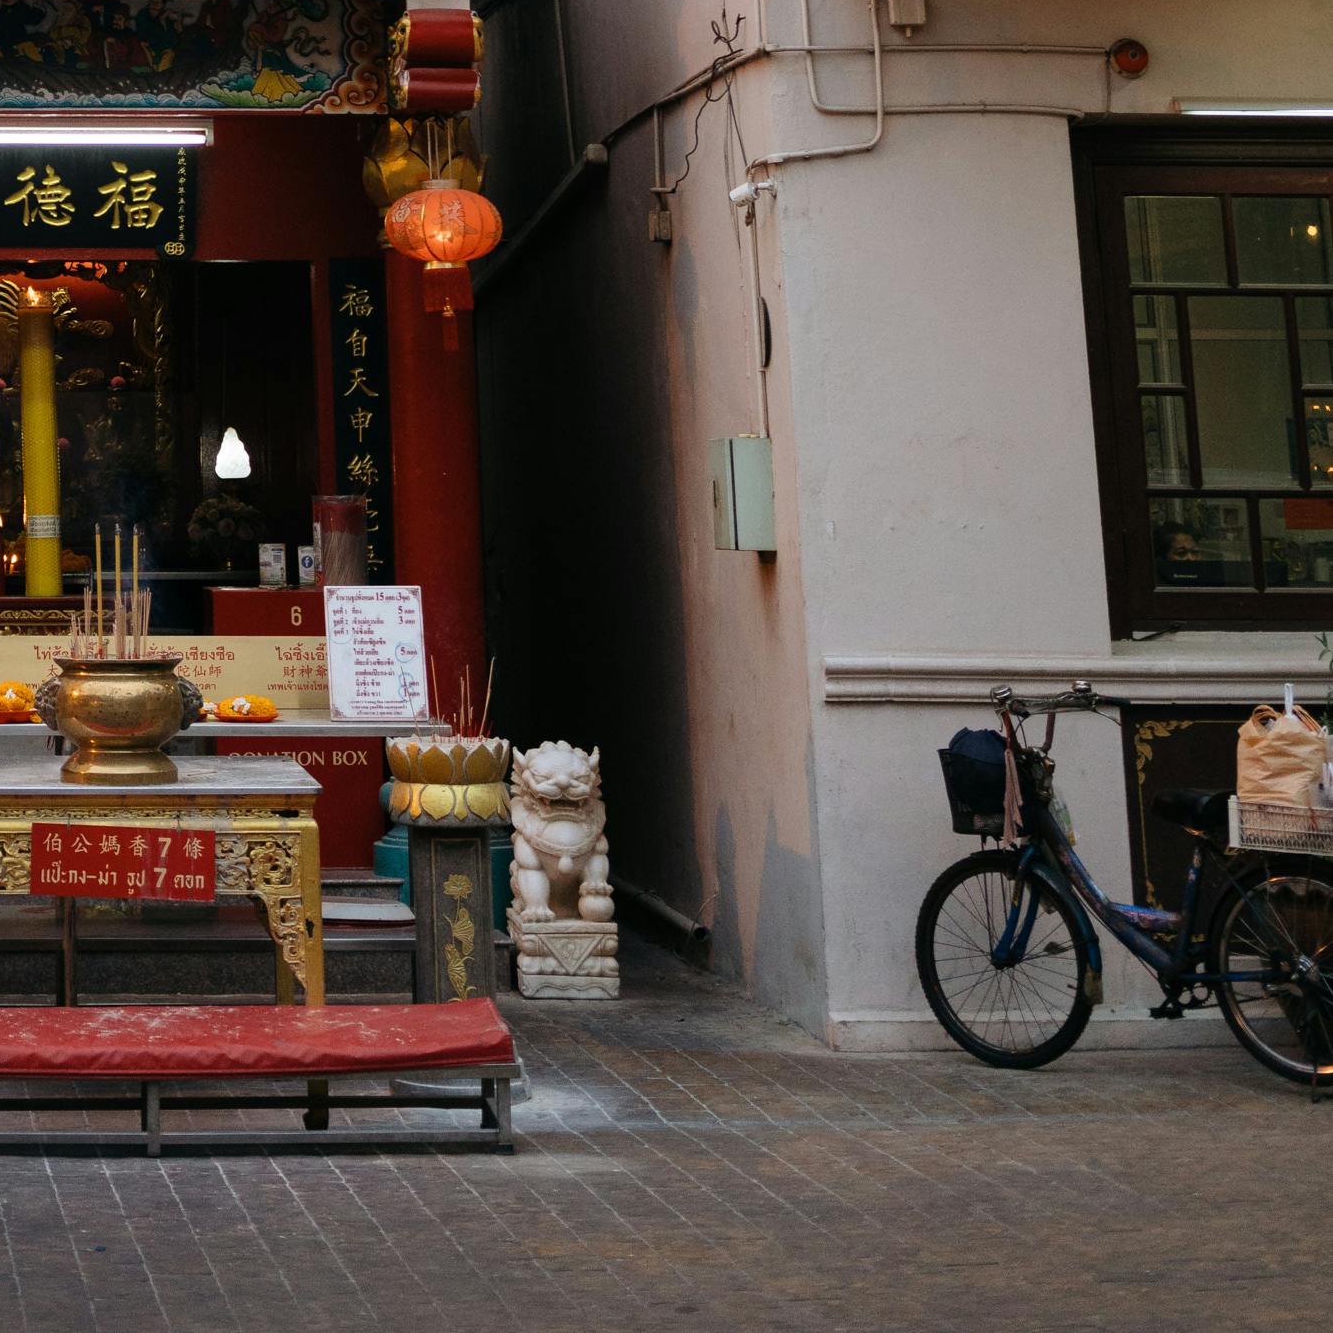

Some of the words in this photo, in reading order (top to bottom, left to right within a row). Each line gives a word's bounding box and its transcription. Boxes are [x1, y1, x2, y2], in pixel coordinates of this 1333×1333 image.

[376, 593, 384, 601] 15
[398, 606, 403, 614] 5
[291, 606, 302, 626] 6
[398, 616, 403, 624] 3
[400, 647, 406, 655] 5
[333, 750, 368, 766] BOX
[153, 868, 167, 888] 7
